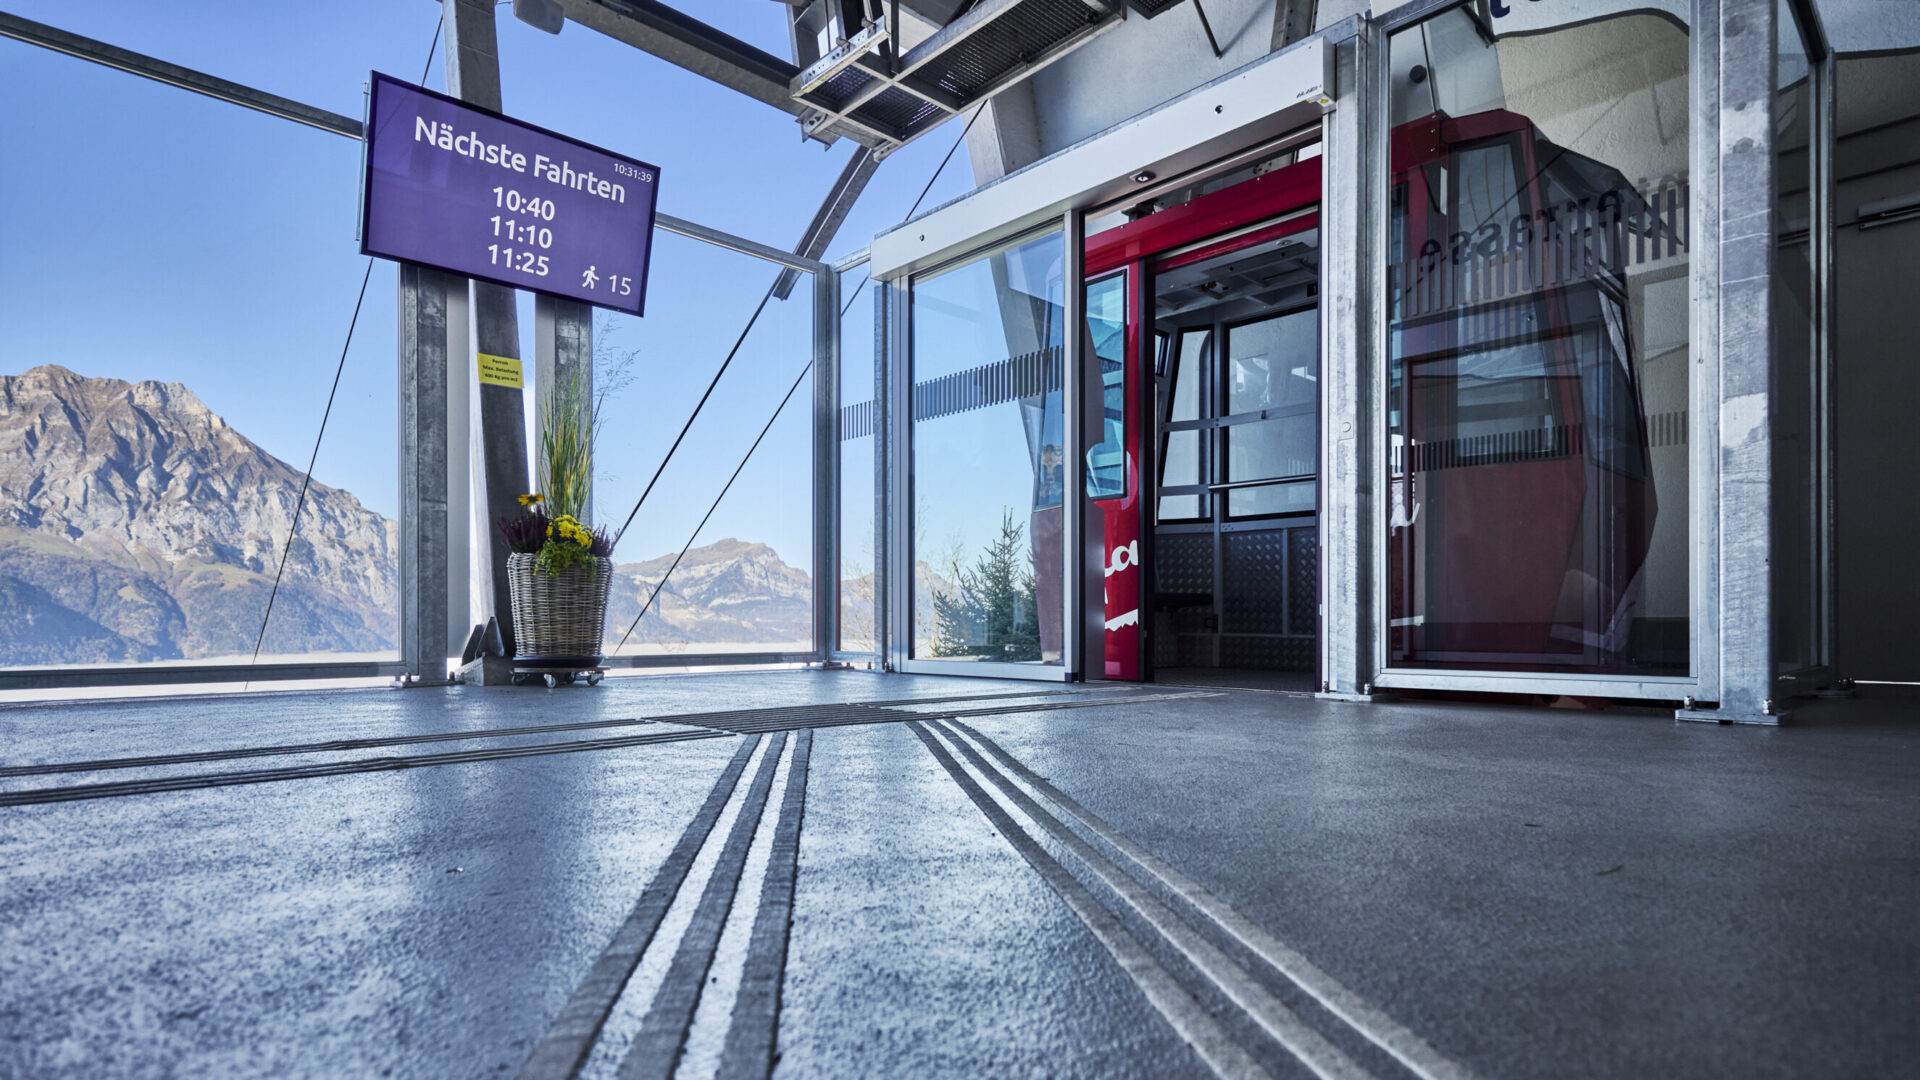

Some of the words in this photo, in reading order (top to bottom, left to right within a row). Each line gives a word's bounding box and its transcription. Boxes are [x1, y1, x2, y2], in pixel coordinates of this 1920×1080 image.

[415, 116, 527, 173] Nächste
[533, 154, 625, 203] Fahrten
[613, 163, 652, 183] 10:31:39
[493, 187, 555, 221] 10:40
[490, 216, 553, 249] 11:10
[488, 244, 549, 276] 11:25
[609, 274, 632, 296] 15
